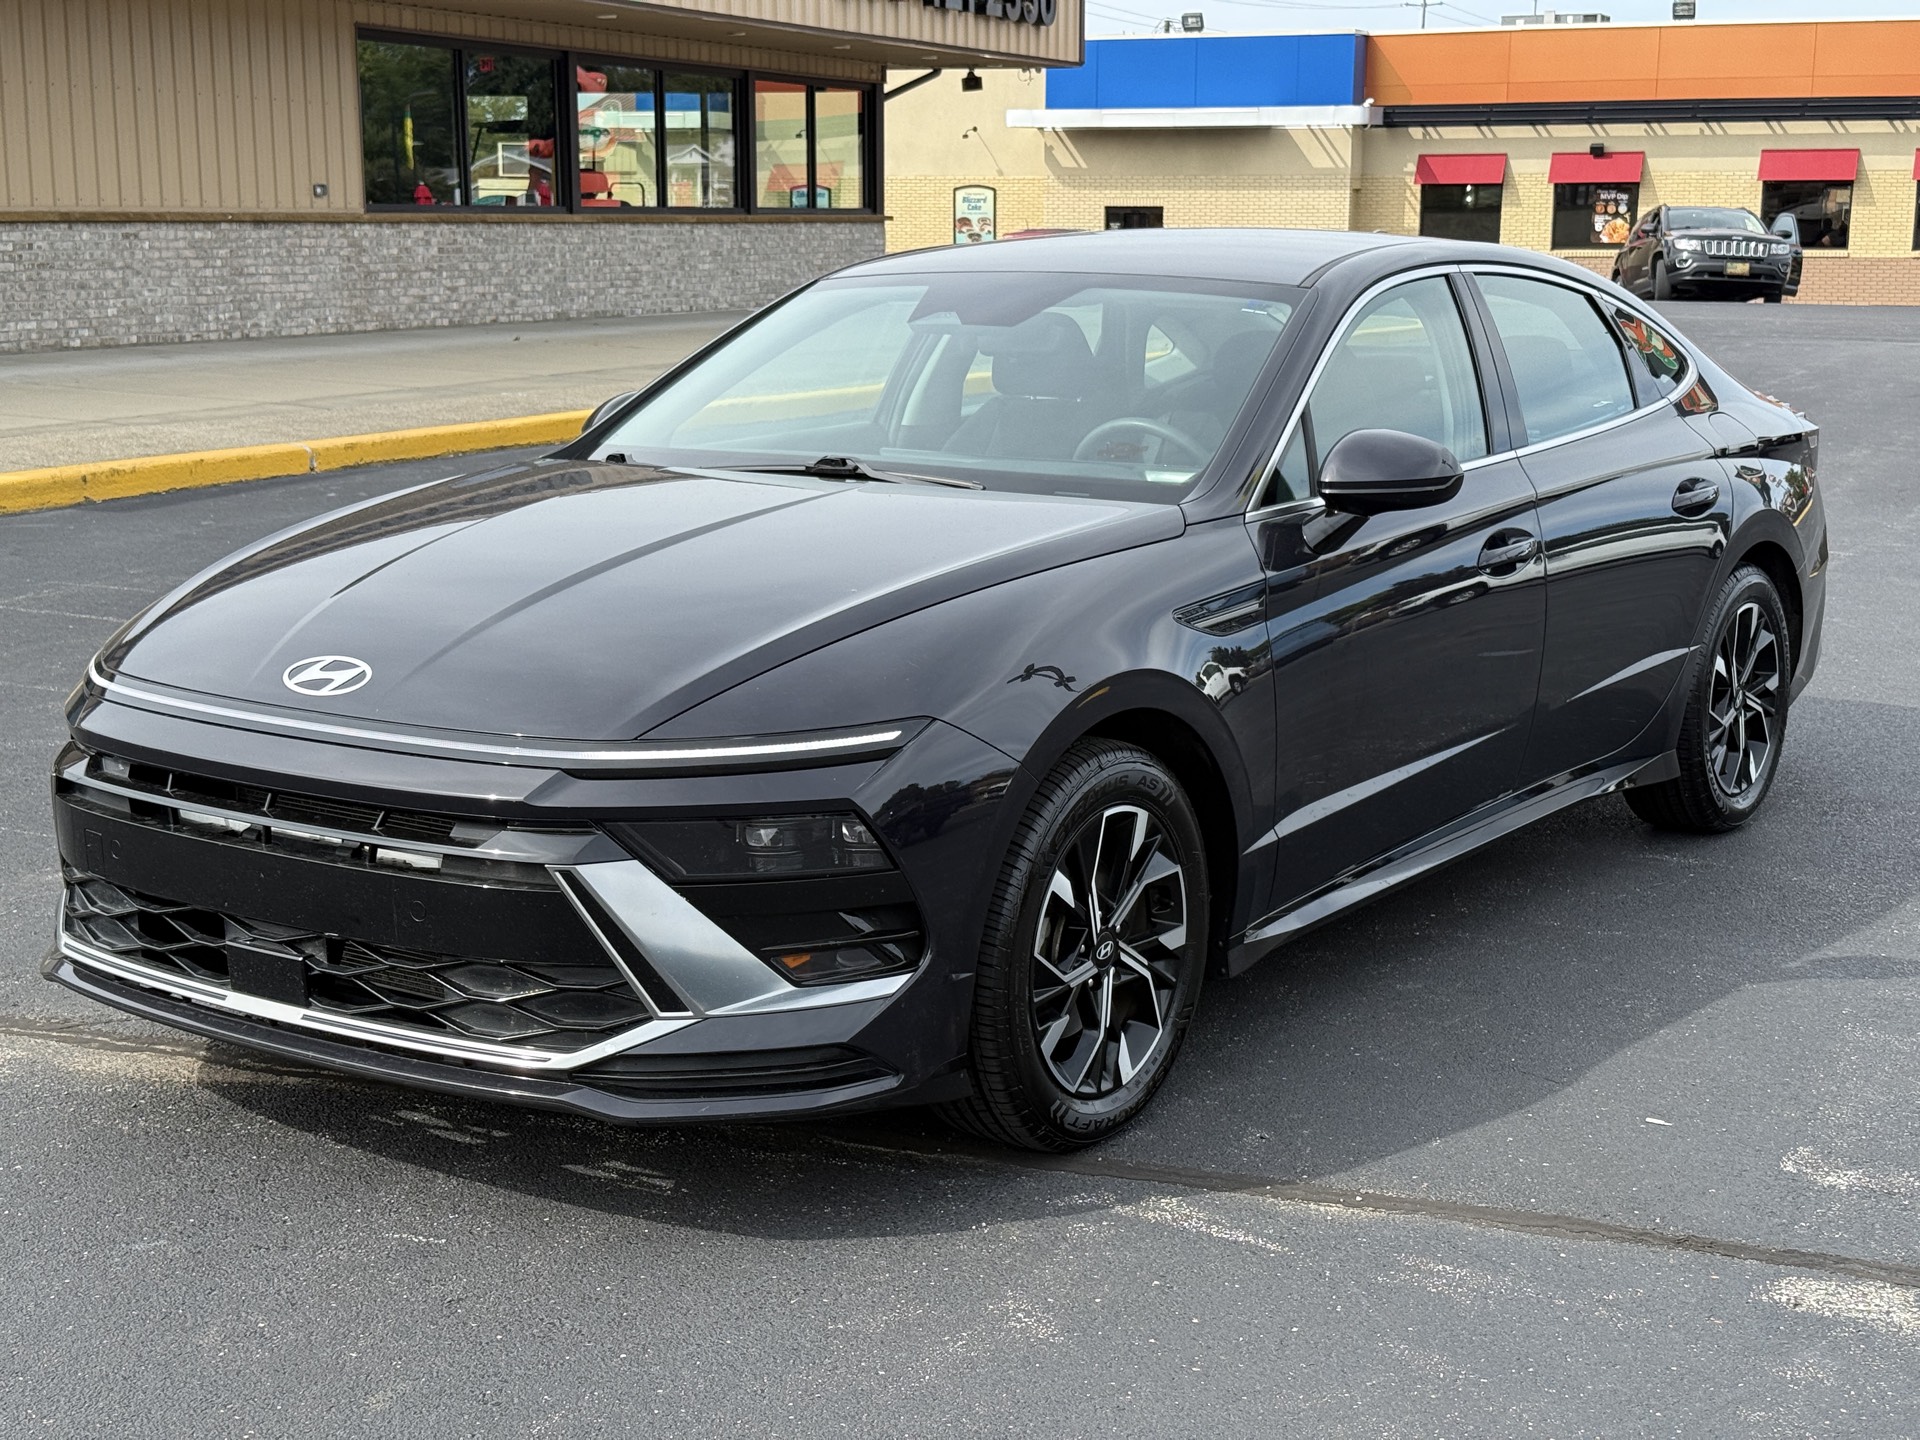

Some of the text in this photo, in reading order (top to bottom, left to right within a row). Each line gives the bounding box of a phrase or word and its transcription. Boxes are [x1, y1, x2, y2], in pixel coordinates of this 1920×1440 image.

[962, 196, 987, 204] Blizzard
[1616, 193, 1629, 201] Dip
[1053, 774, 1160, 851] STRATUS AS
